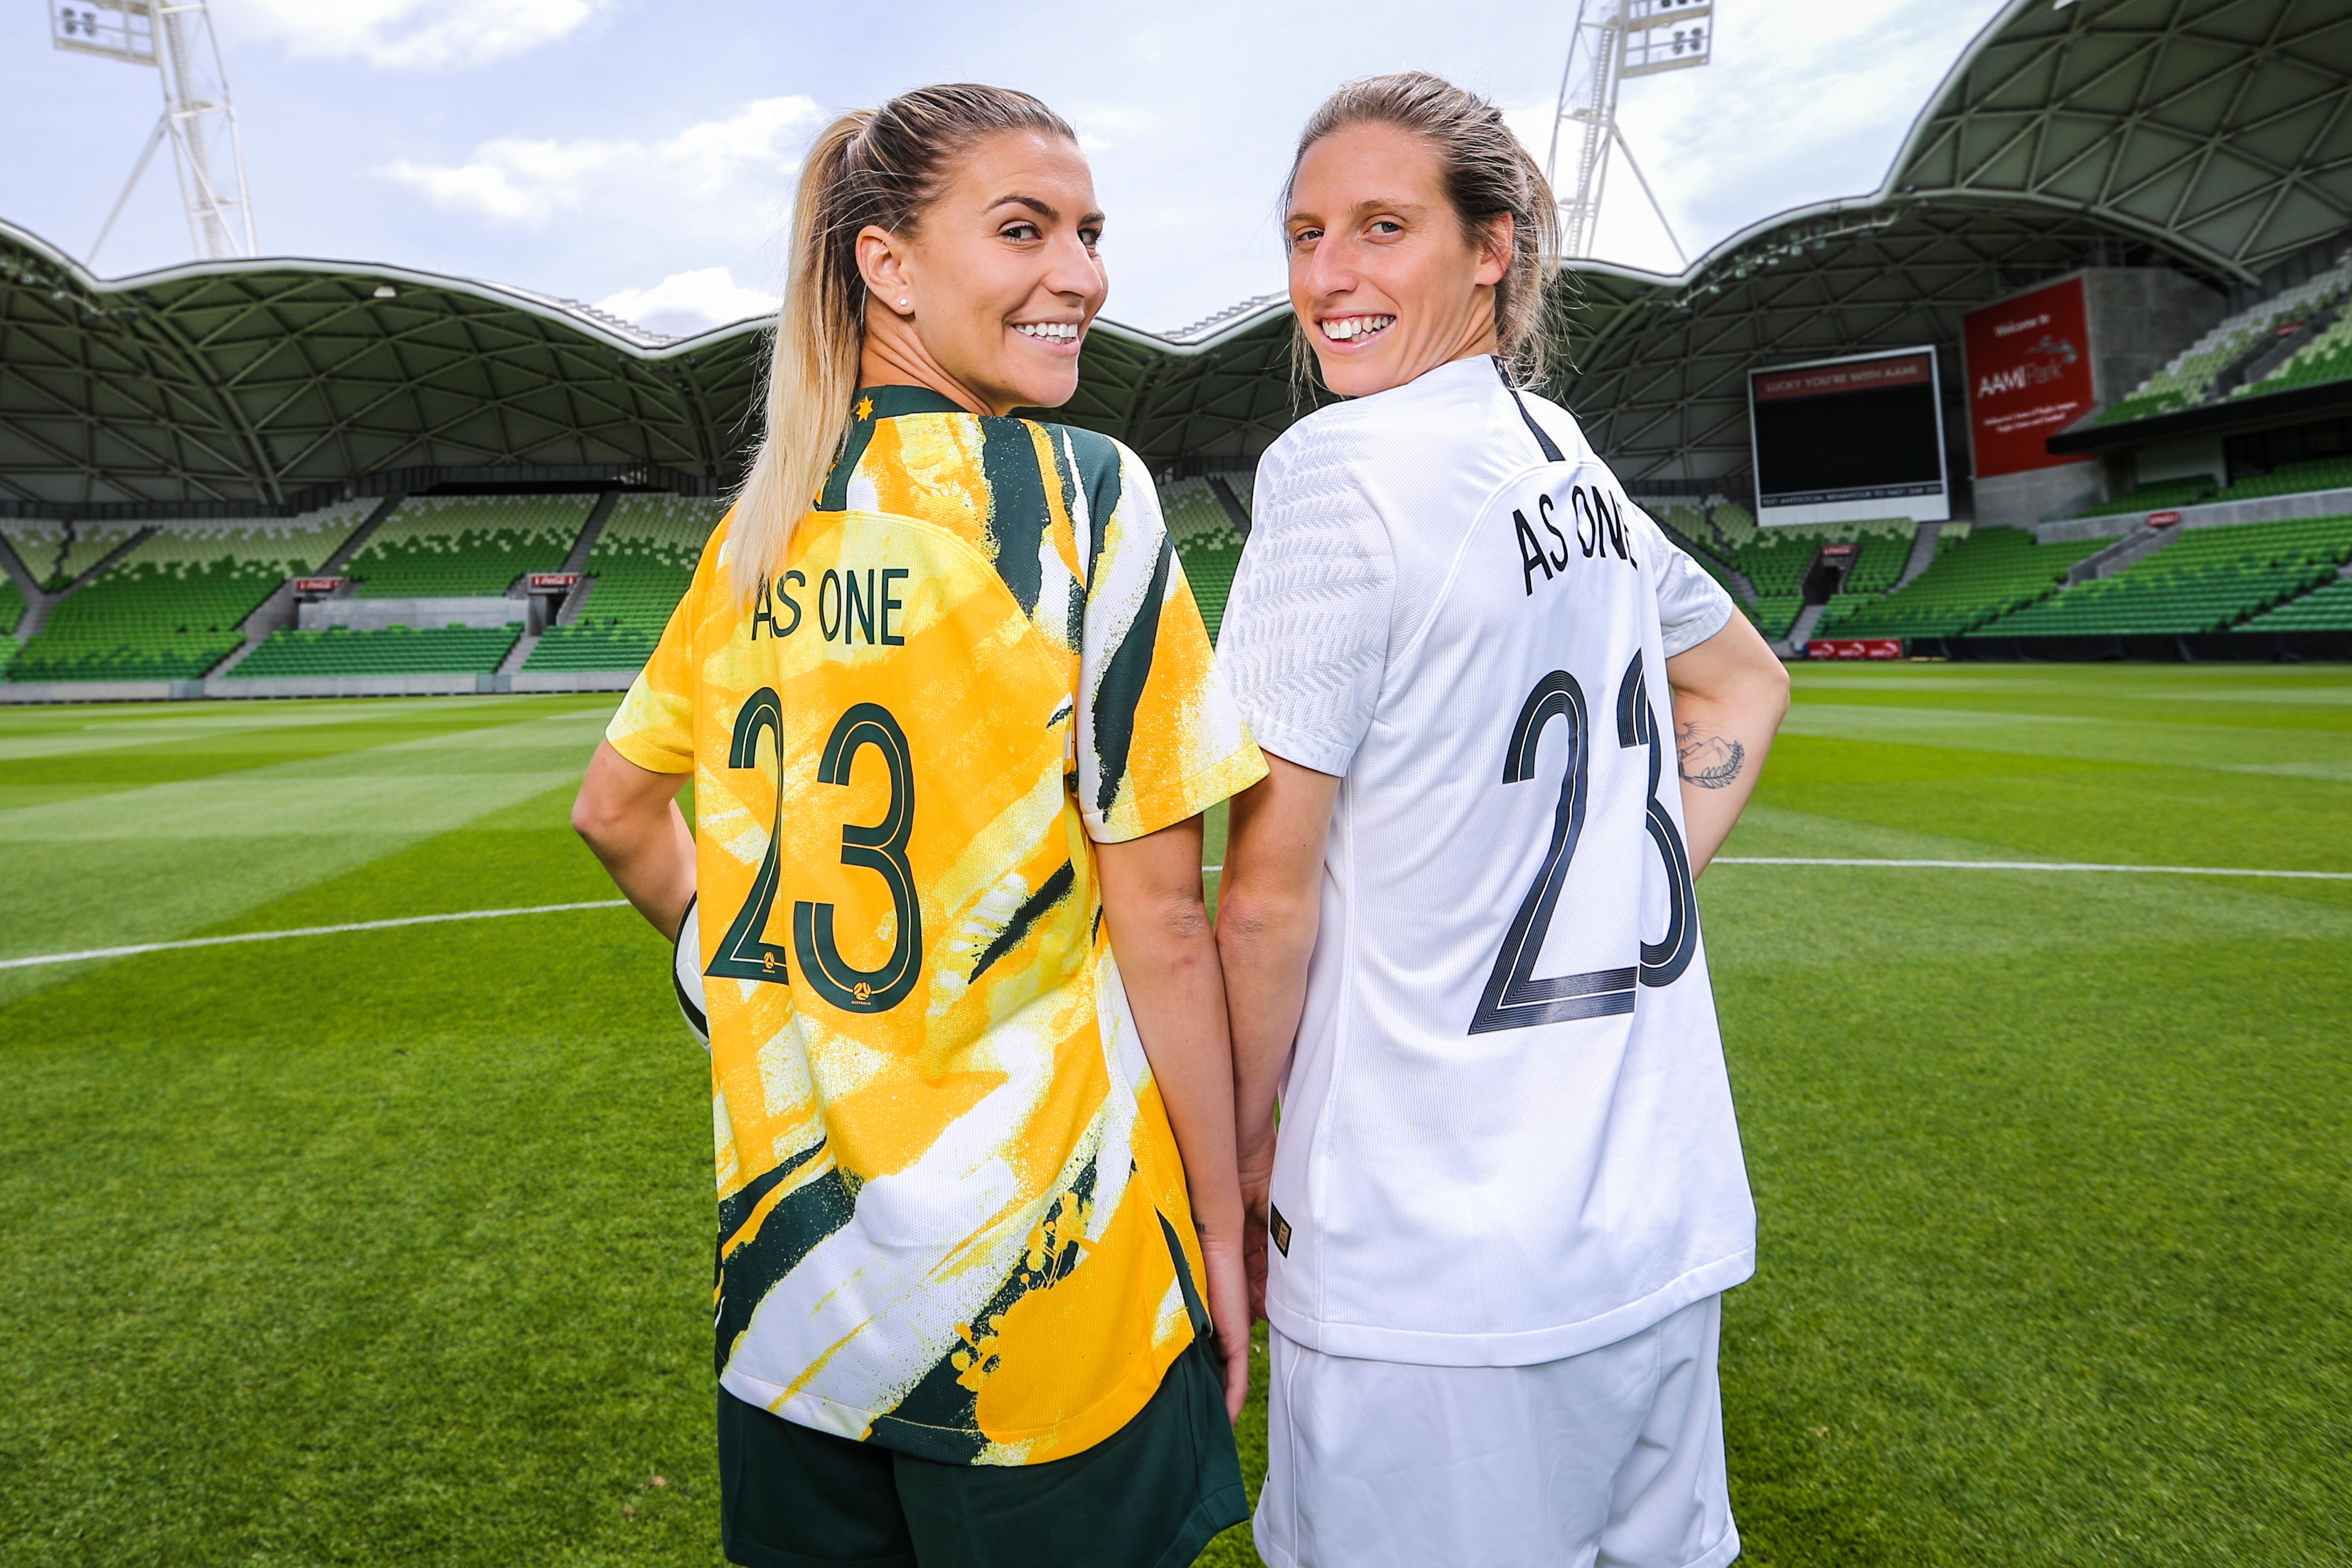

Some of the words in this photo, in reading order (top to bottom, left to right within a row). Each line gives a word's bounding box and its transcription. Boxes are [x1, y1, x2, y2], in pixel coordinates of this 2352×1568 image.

[1994, 319, 2036, 336] Welcome
[1766, 379, 1801, 392] LUCKY
[1513, 494, 1568, 597] AS
[751, 570, 805, 641] AS
[819, 568, 908, 646] ONE
[703, 686, 923, 1014] 23
[1467, 647, 1697, 1036] 23
